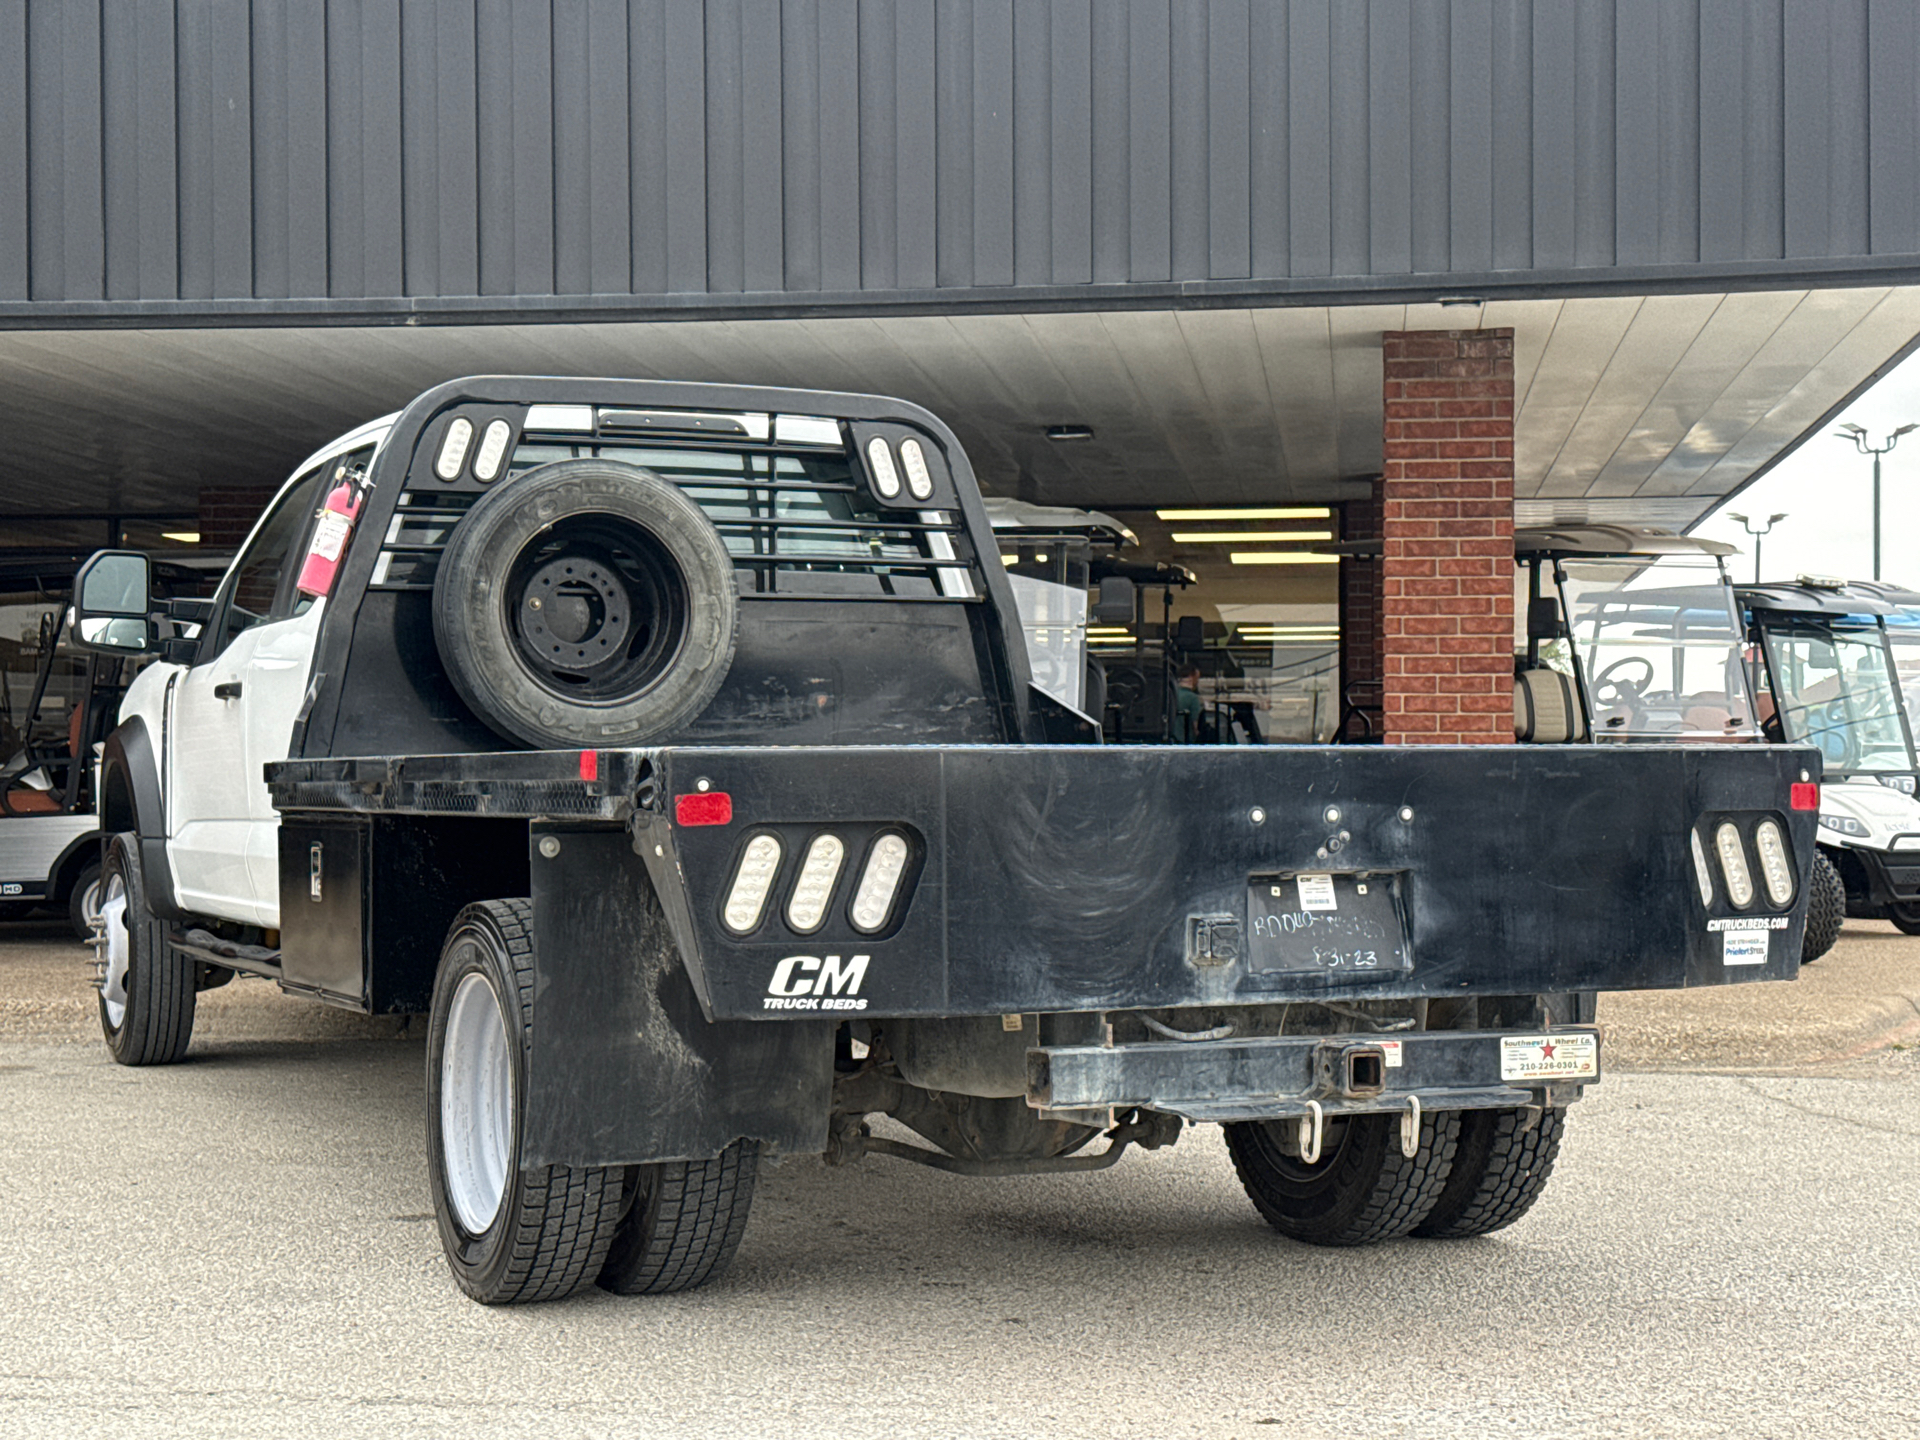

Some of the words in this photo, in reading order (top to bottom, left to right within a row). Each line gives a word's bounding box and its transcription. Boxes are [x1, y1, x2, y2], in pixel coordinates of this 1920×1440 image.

[3, 884, 23, 895] HD
[1707, 918, 1789, 931] CMTRUCKBEDS.COM
[767, 954, 871, 996] CM
[763, 997, 819, 1010] TRUCK
[821, 997, 869, 1010] BEDS
[1504, 1039, 1544, 1047] Southwest
[1554, 1037, 1578, 1045] Wheel
[1520, 1061, 1578, 1070] 210-226-0301
